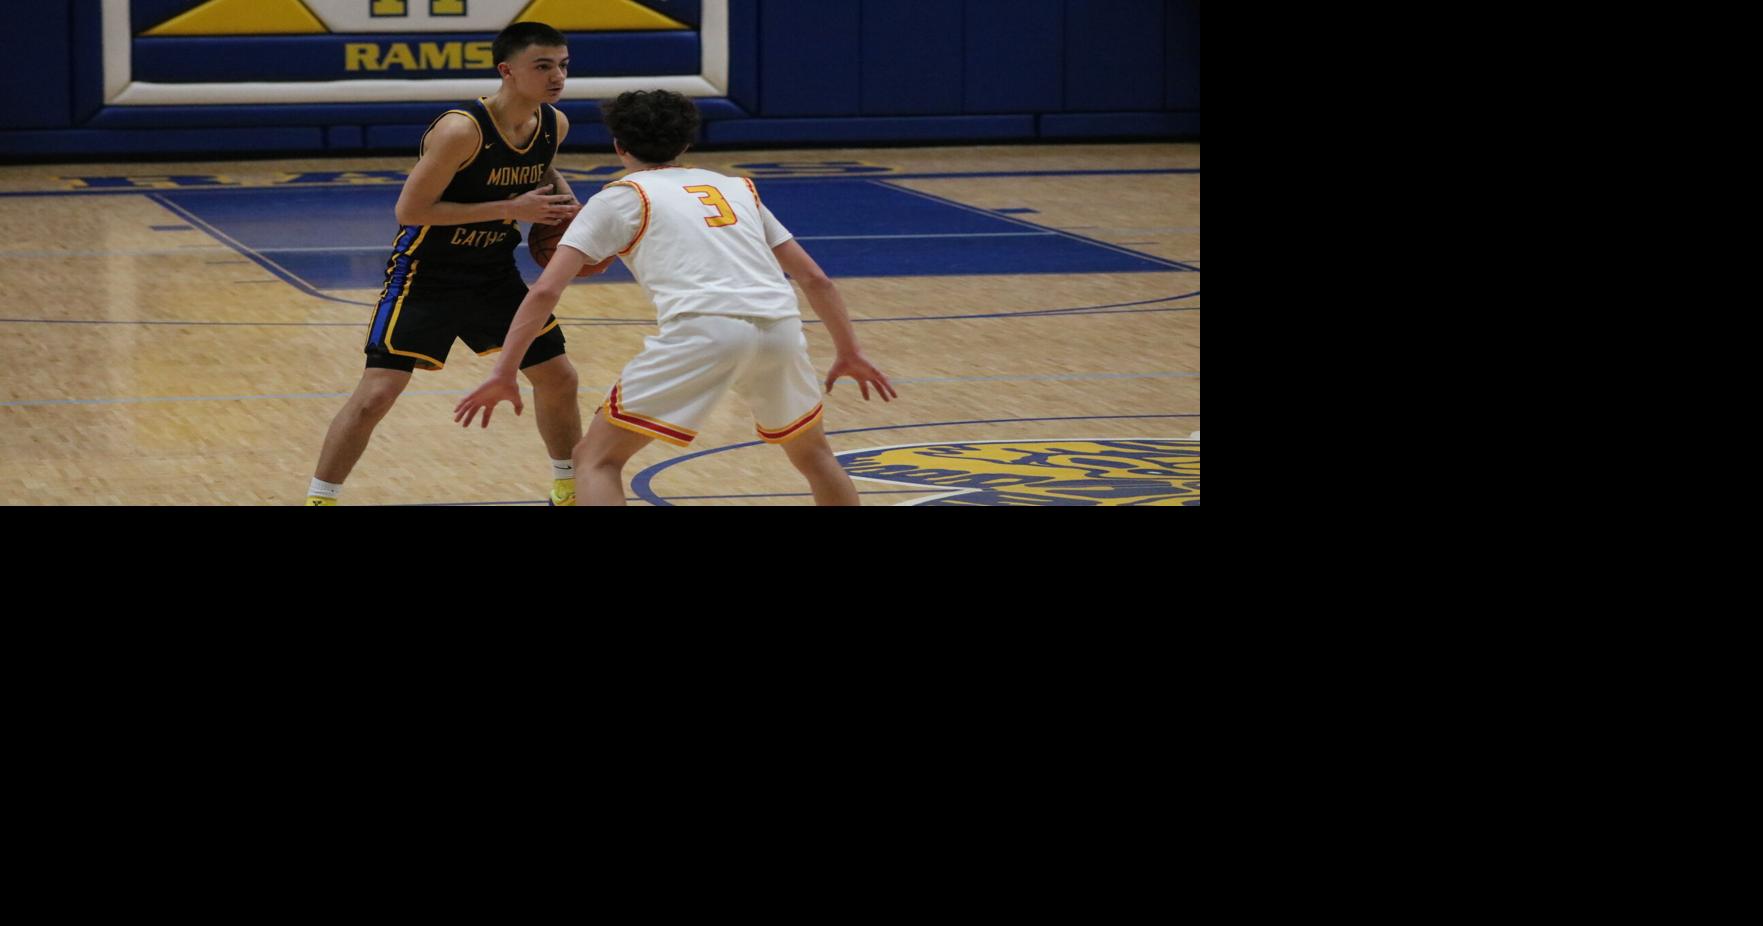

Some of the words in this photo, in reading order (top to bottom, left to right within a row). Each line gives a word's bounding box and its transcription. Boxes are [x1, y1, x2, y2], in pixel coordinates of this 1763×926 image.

[344, 42, 494, 71] RAMS
[486, 163, 545, 186] MONROE
[682, 184, 738, 228] 3
